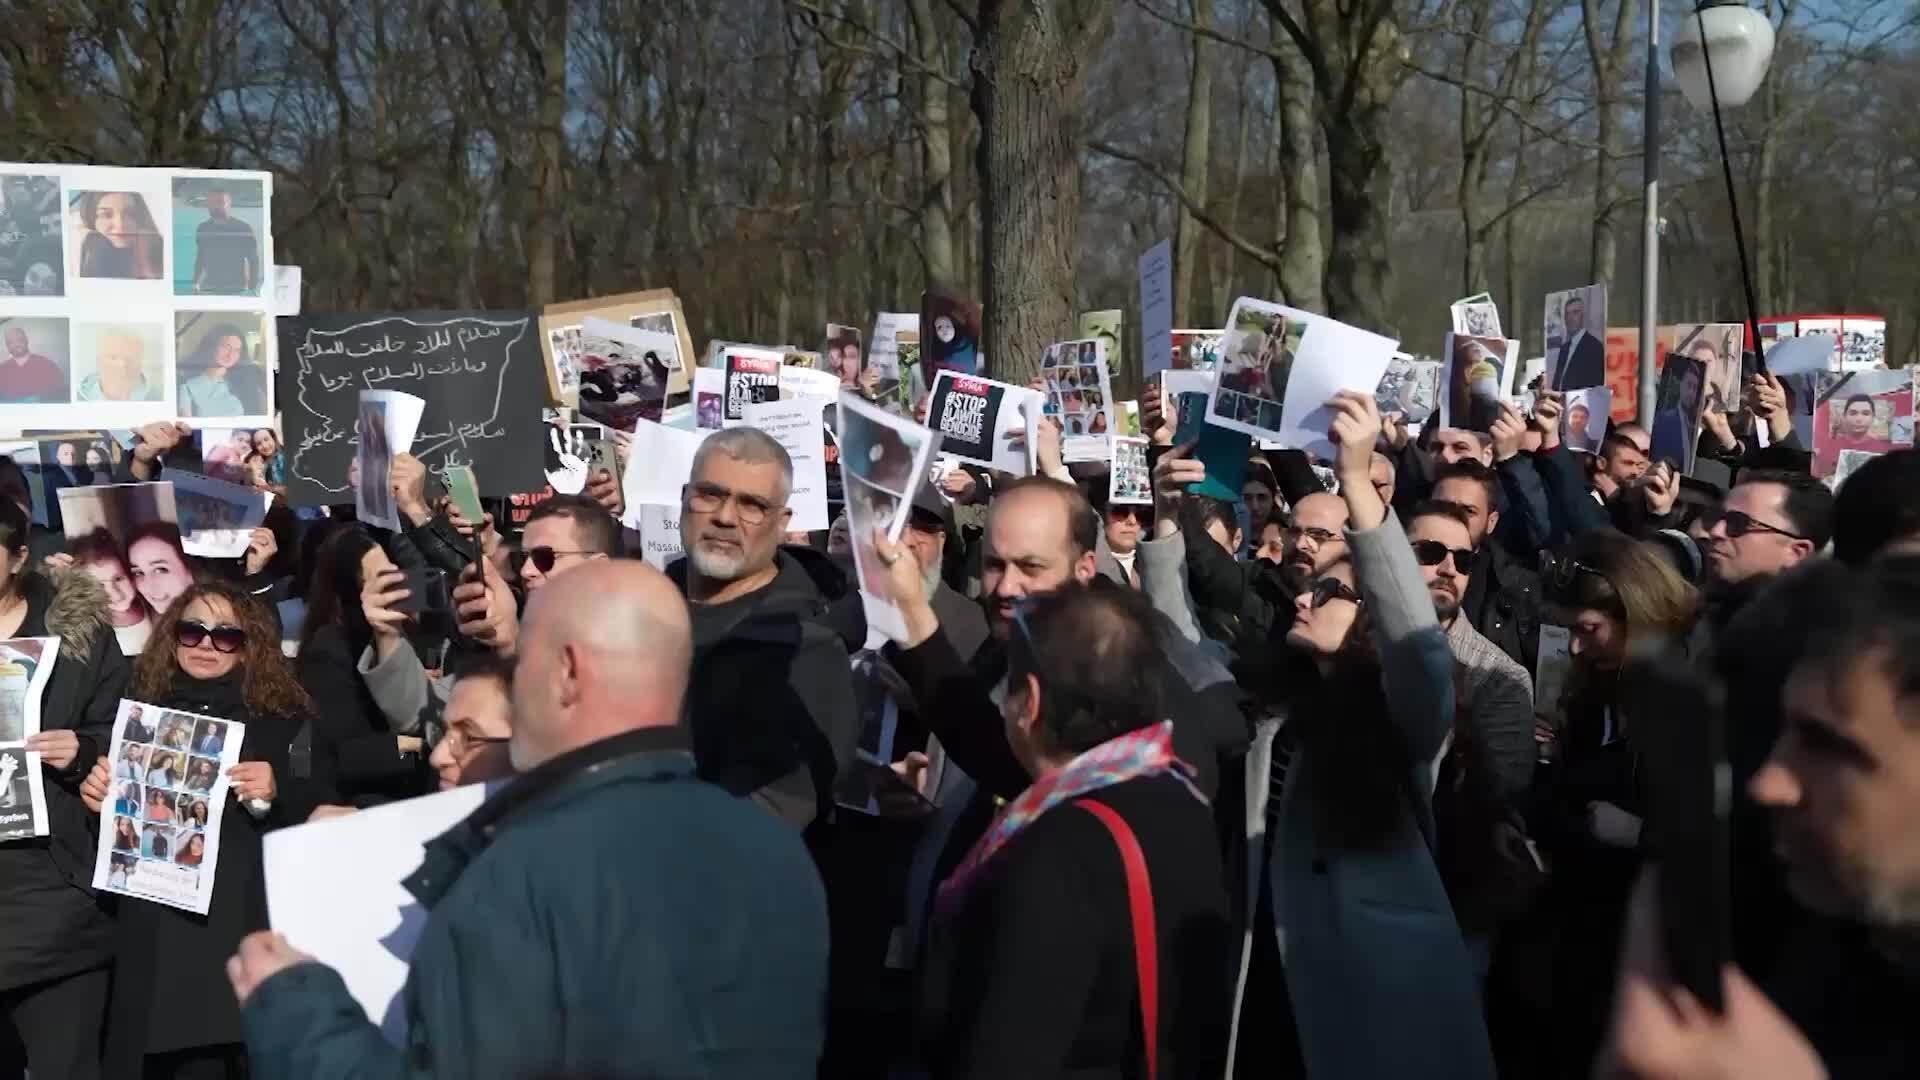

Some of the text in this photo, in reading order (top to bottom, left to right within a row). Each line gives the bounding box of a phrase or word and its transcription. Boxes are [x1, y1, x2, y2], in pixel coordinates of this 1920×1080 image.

[456, 327, 500, 351] سلام
[958, 379, 983, 391] SYRIA
[944, 391, 988, 412] #STOP
[942, 405, 985, 425] ALAWITE
[940, 418, 983, 437] GENOCIDE
[663, 519, 681, 530] Sto
